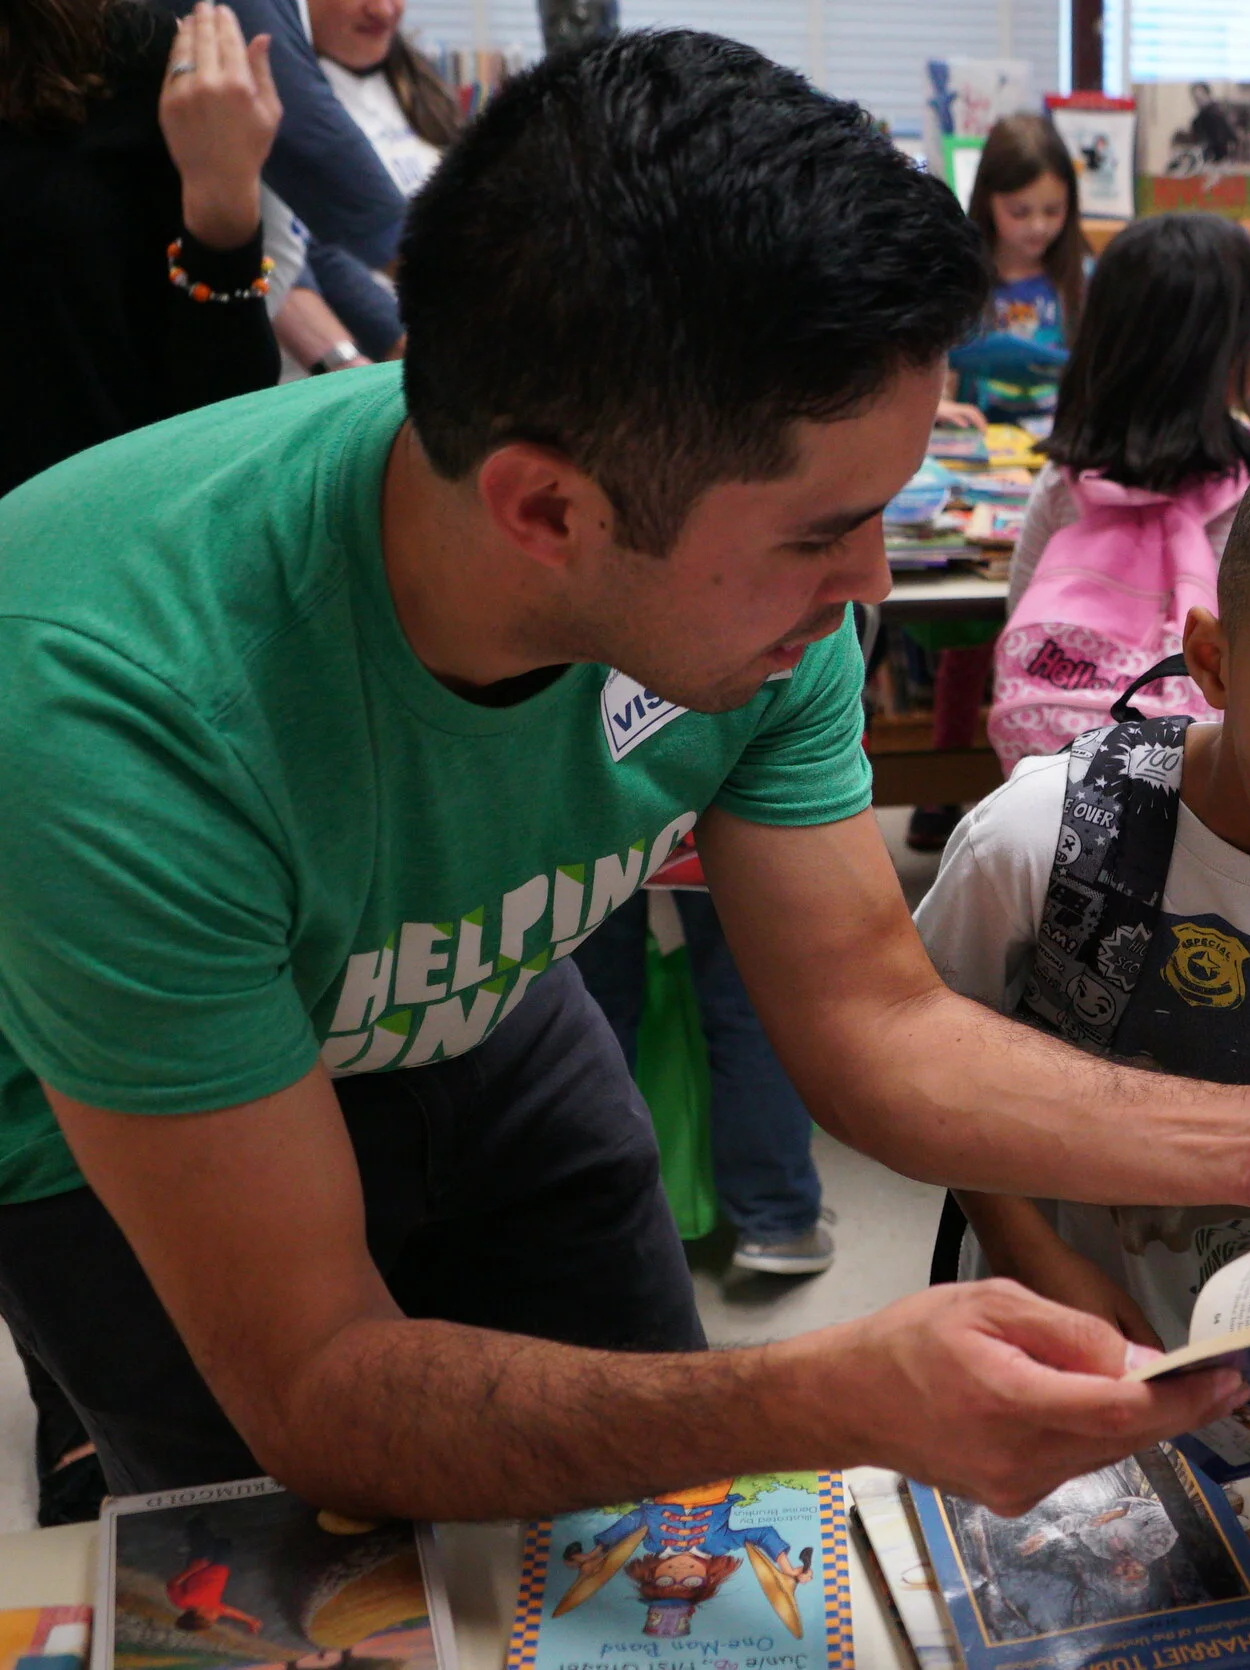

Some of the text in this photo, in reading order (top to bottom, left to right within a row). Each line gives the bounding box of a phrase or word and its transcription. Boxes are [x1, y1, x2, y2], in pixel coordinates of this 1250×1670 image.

[1027, 638, 1111, 691] Hello
[612, 686, 668, 733] VIS
[1136, 748, 1180, 772] 100
[1073, 802, 1115, 828] OVER
[1152, 1631, 1176, 1642] the
[1178, 1626, 1192, 1638] of
[598, 1635, 775, 1659] One-Man Band
[745, 1653, 808, 1670] Junie
